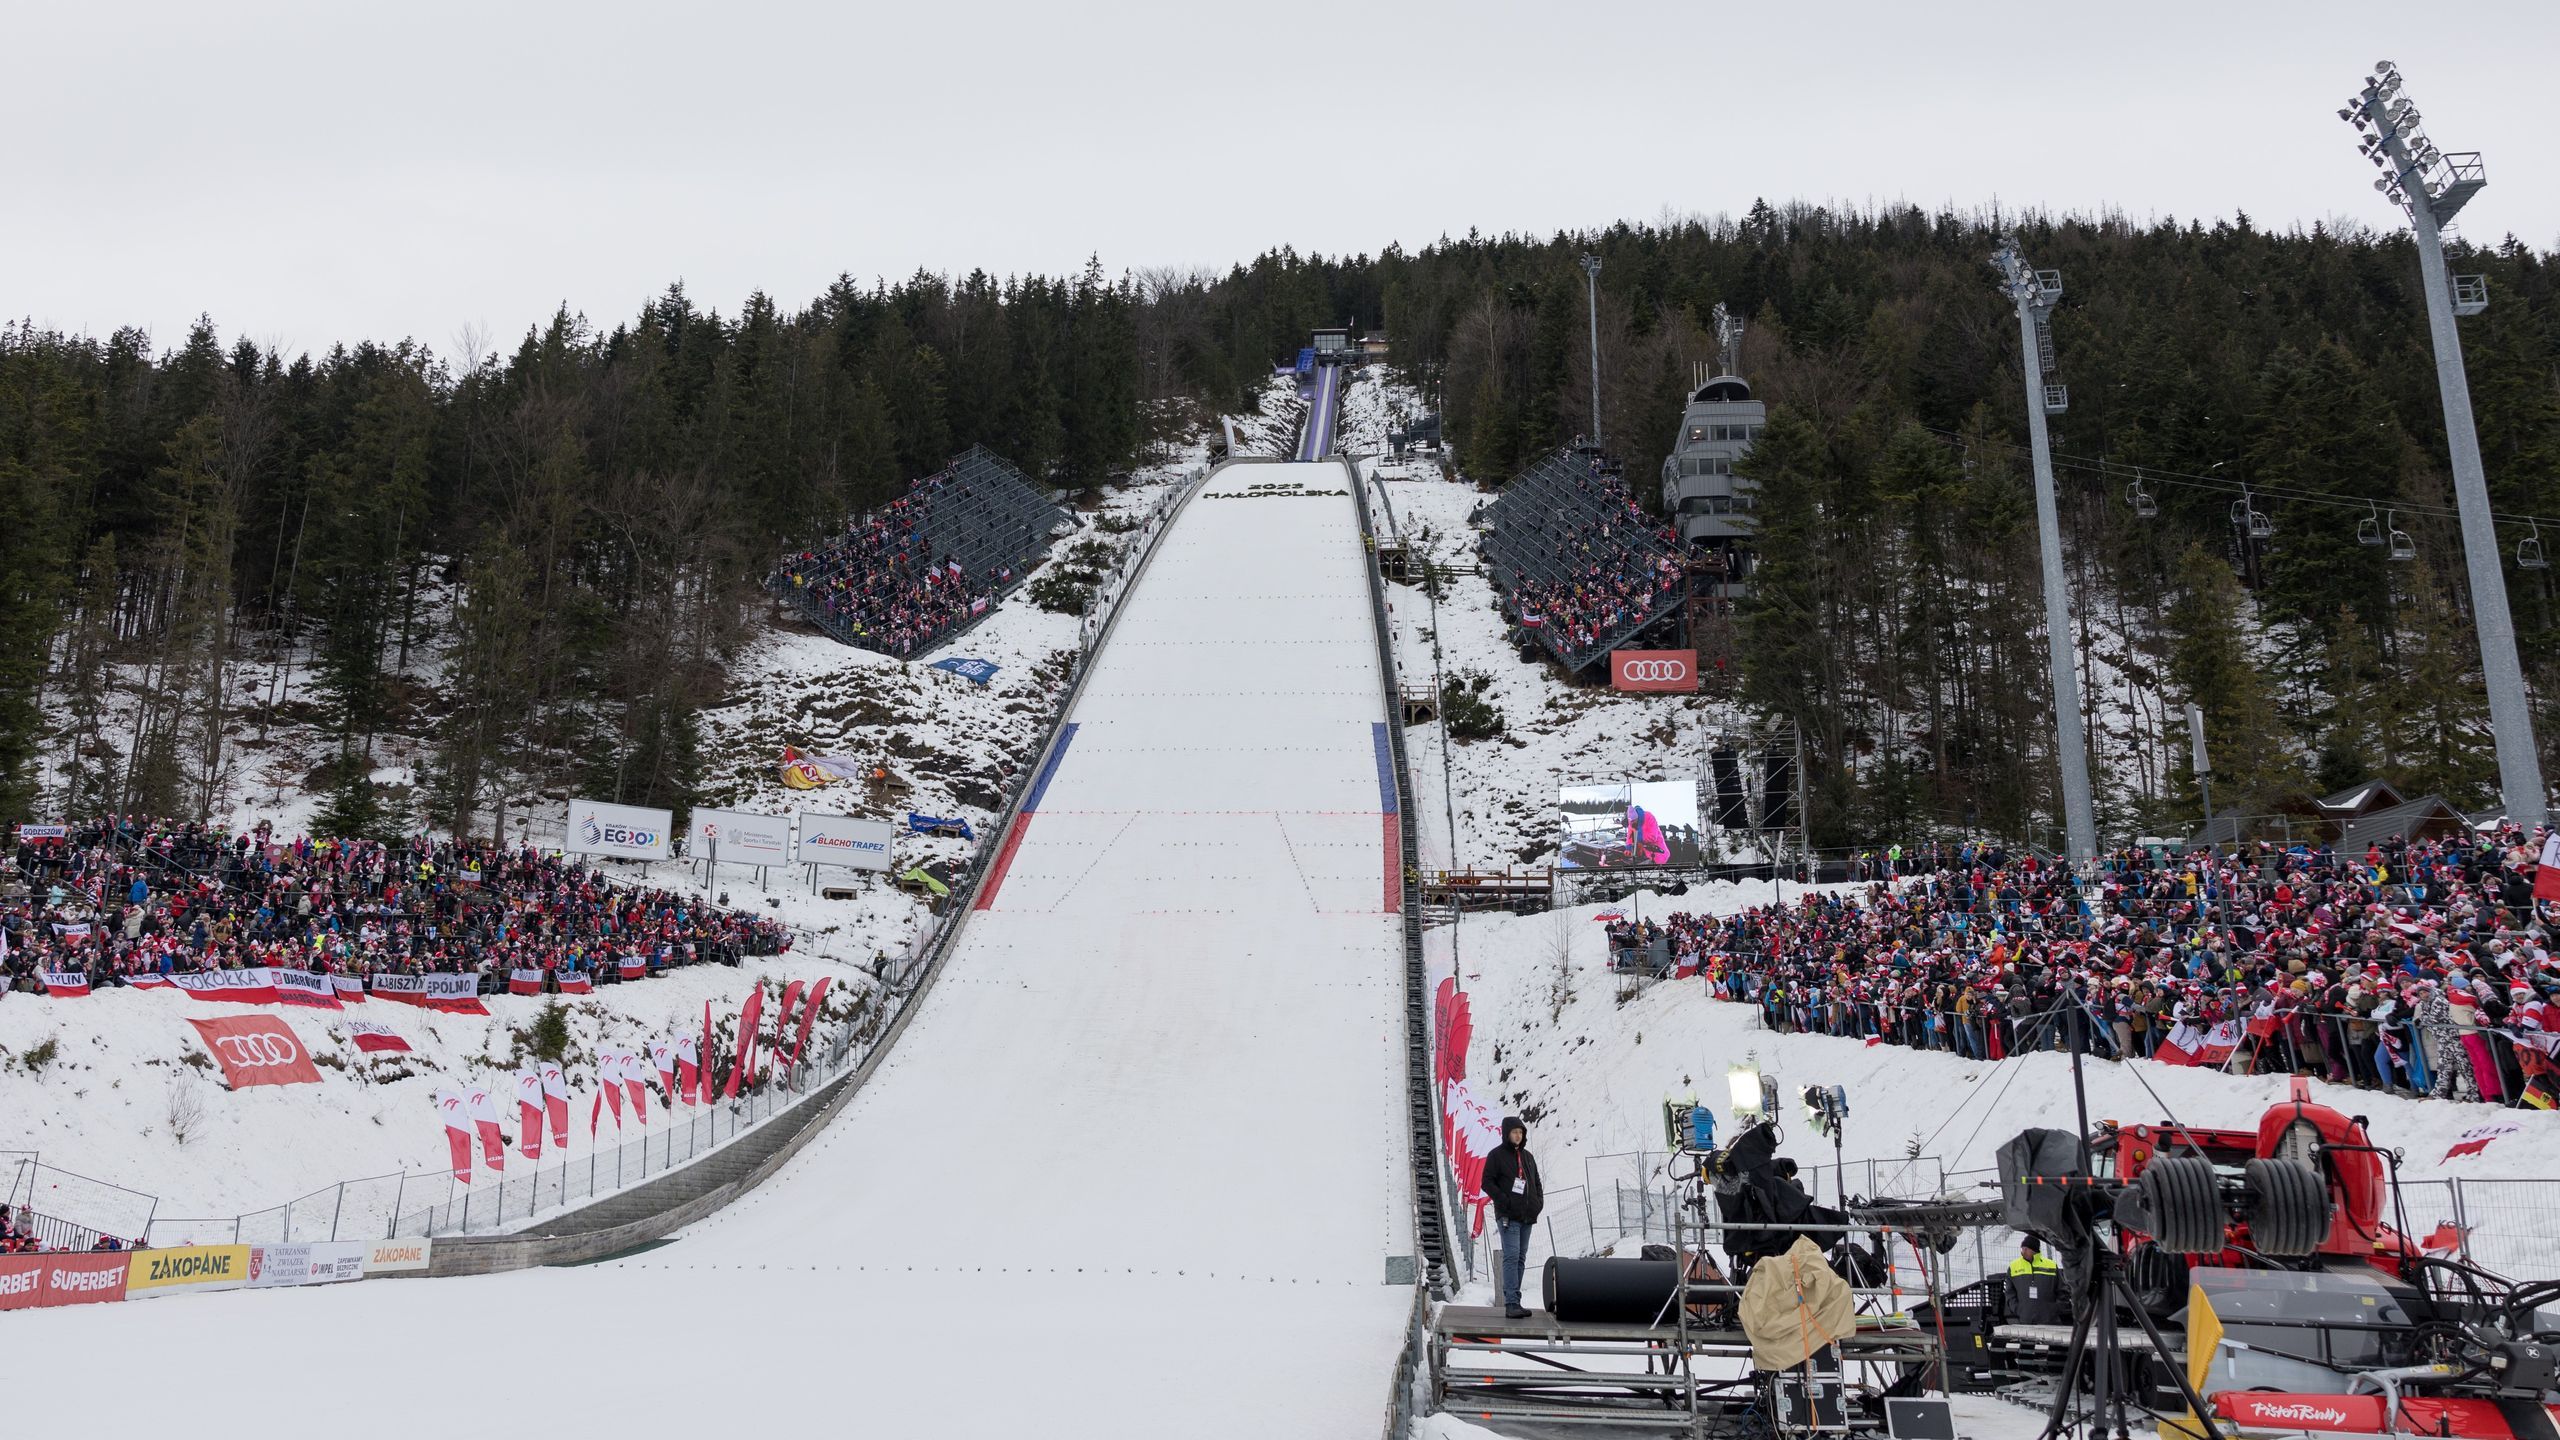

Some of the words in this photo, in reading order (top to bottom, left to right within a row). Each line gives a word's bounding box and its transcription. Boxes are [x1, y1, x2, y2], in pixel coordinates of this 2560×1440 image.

[1203, 489, 1349, 499] MAŁOPOLSKA
[23, 827, 63, 836] GODZISZÓW
[744, 831, 774, 839] Ministerstwo
[762, 838, 781, 846] Turystyki
[818, 837, 885, 851] BLACHOTRAPEZ
[49, 975, 82, 985] TYLIN
[178, 971, 261, 989] SOKÓŁKA
[378, 976, 426, 990] ŁABISZYN
[427, 978, 471, 997] ĘPÓLNO
[275, 1248, 311, 1256] TATRZAŃSKI
[373, 1245, 423, 1263] ZAKOPANE
[150, 1252, 231, 1281] ZAKOPANE
[272, 1268, 307, 1277] NARCIARSKI
[50, 1265, 125, 1291] SUPERBET
[2250, 1402, 2346, 1425] PistenBully
